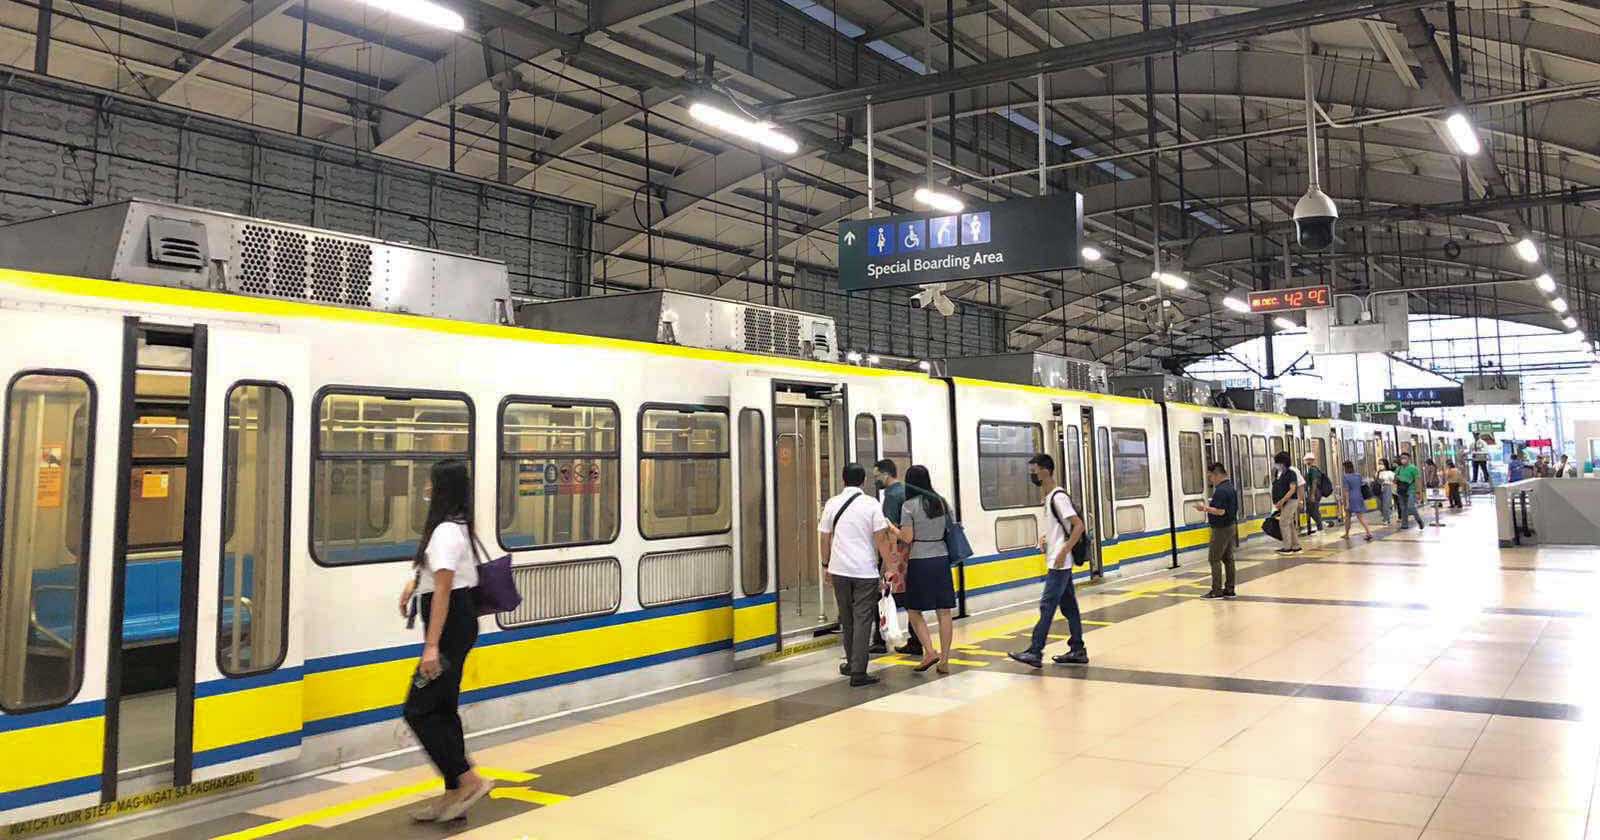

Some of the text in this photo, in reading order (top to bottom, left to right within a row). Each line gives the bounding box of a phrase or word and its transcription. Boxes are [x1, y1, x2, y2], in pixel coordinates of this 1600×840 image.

[867, 252, 1004, 279] Special Boarding Area
[1284, 291, 1303, 306] 42
[1356, 402, 1381, 413] EXIT
[9, 771, 255, 835] WATCH YOUR STEP MAG-INGAT SA PAGHAKBANG
